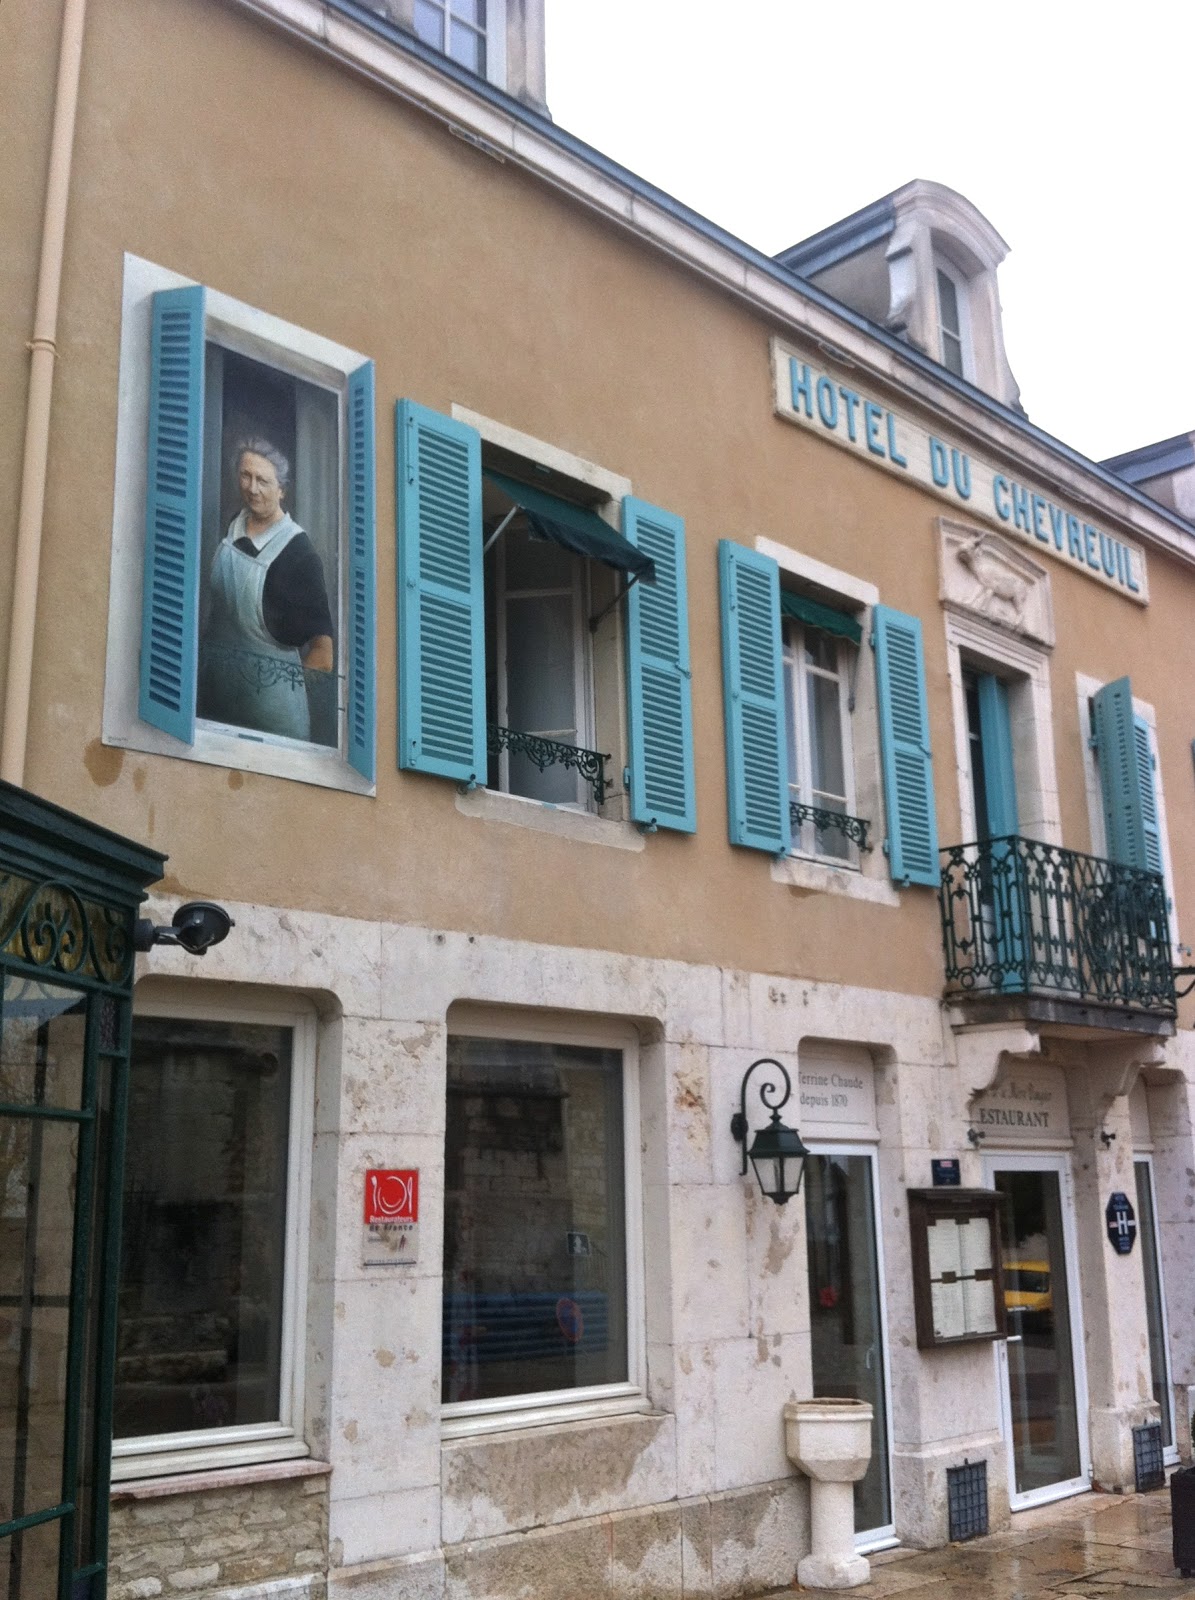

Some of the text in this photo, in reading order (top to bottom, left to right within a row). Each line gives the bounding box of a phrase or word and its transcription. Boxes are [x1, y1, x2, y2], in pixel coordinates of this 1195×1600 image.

[788, 355, 1140, 593] HOTEL DU CHEVREUIL
[831, 1073, 864, 1090] Chaude
[800, 1091, 829, 1108] depuis
[979, 1107, 1049, 1128] ESTAURANT
[1116, 1211, 1129, 1235] H
